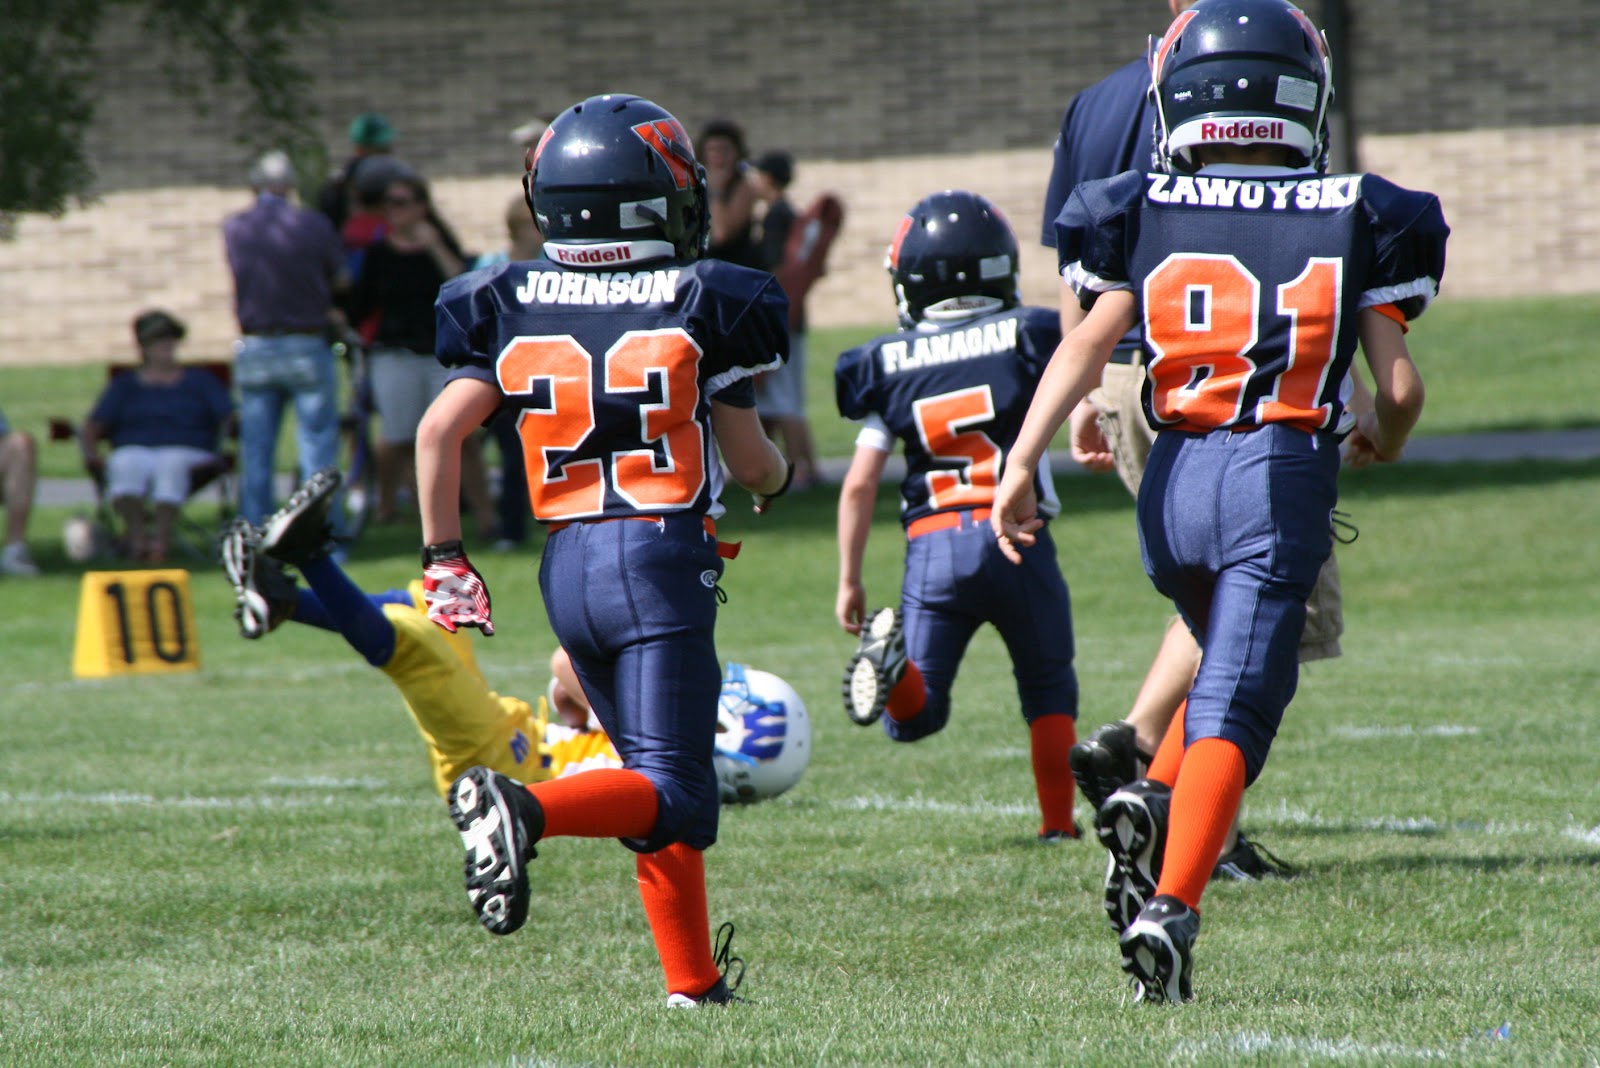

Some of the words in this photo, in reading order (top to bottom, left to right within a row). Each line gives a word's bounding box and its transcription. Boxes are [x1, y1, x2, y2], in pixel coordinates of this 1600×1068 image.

[1201, 122, 1284, 139] Riddell
[1147, 172, 1363, 210] ZAWOYSKI
[557, 246, 632, 263] Riddell
[516, 270, 680, 305] JOHNSON
[881, 318, 1018, 375] FLANAGAN
[1143, 252, 1343, 432] 81
[496, 327, 706, 521] 23
[913, 384, 1002, 510] 5
[105, 582, 187, 664] 10
